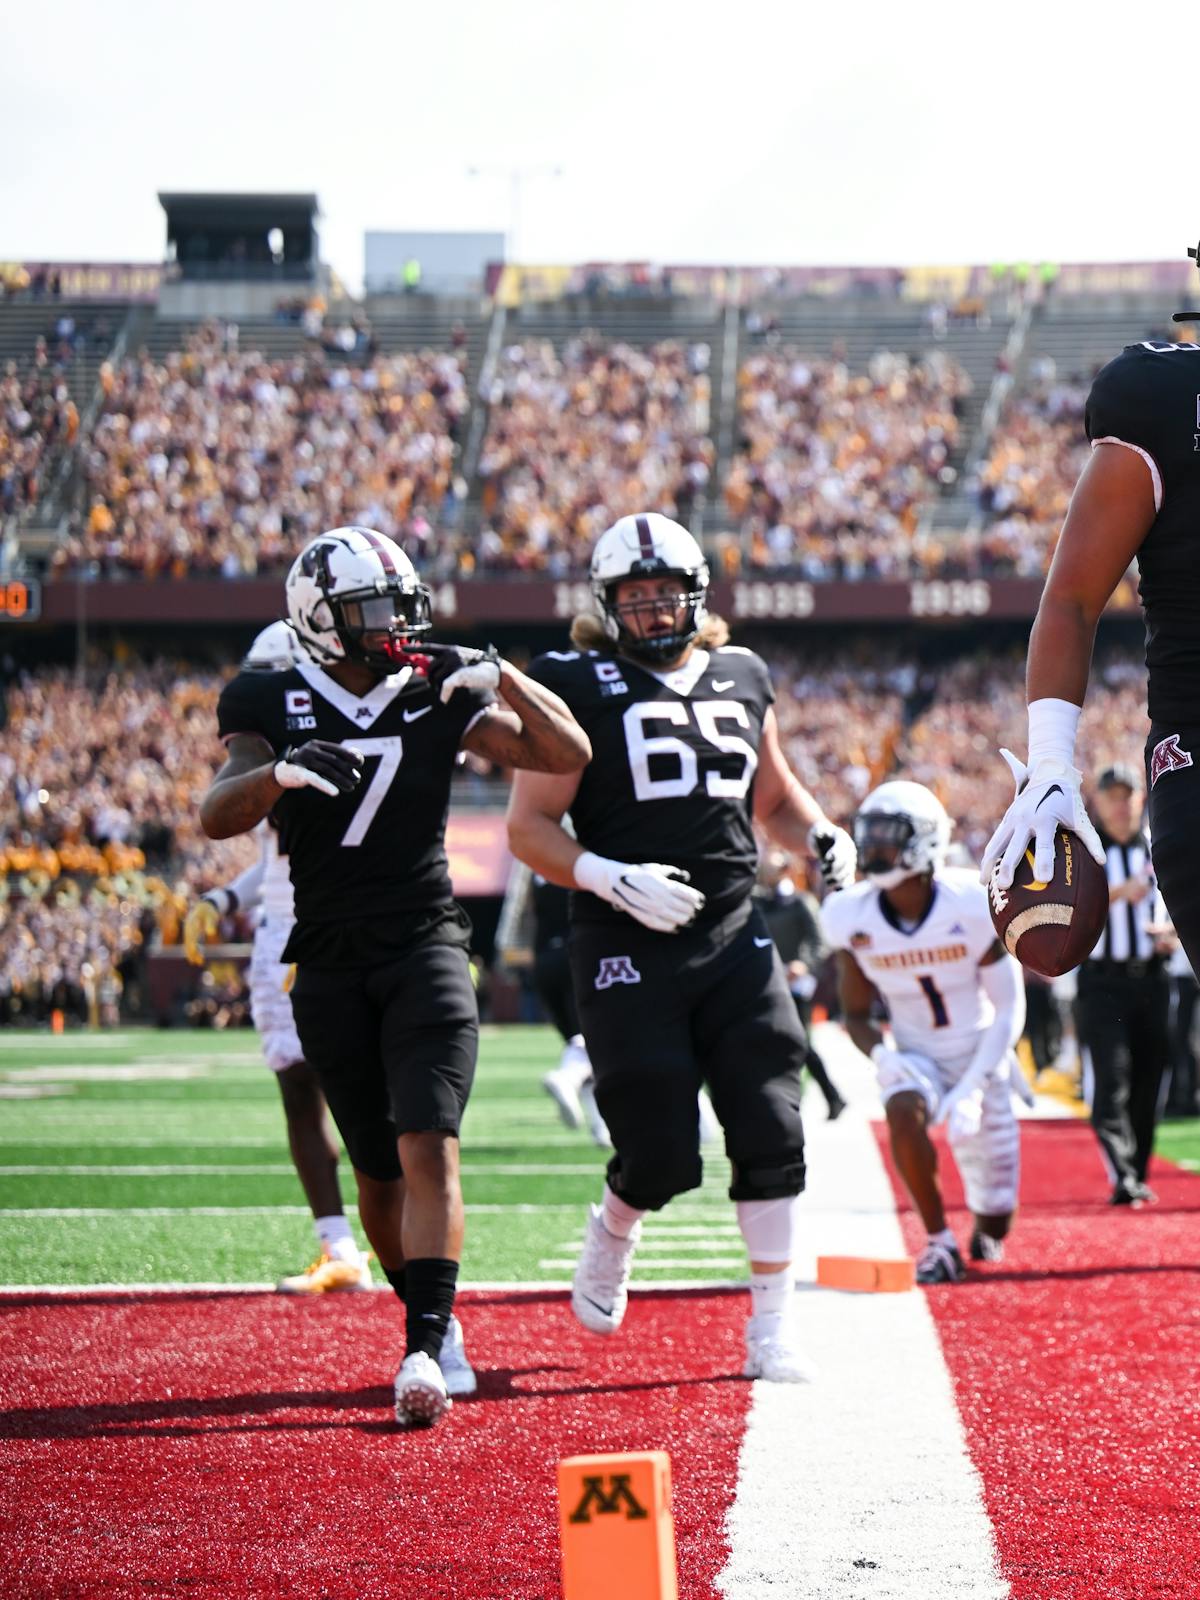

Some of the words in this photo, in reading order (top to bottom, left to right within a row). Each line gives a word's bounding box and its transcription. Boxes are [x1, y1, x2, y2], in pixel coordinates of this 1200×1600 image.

[287, 690, 311, 714] C
[623, 700, 758, 802] 65
[340, 736, 403, 847] 7
[595, 955, 641, 991] M
[915, 973, 950, 1029] 1
[568, 1474, 648, 1524] M
